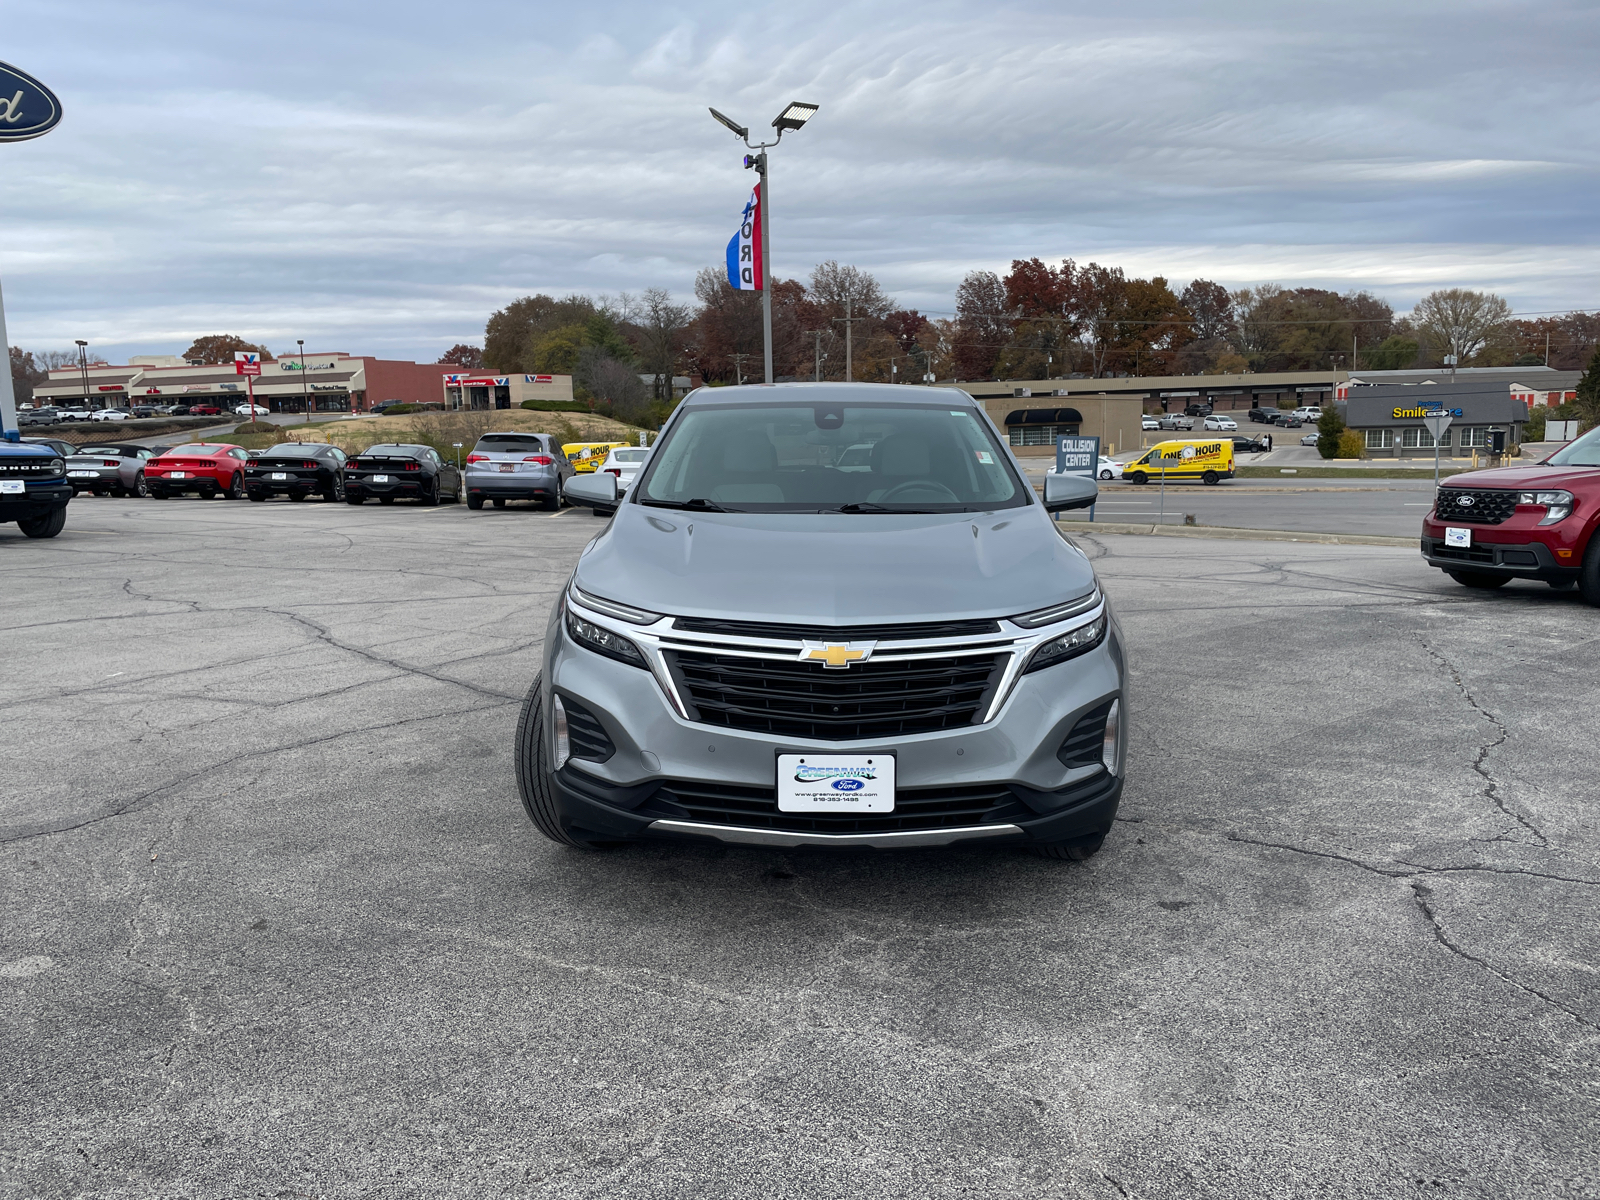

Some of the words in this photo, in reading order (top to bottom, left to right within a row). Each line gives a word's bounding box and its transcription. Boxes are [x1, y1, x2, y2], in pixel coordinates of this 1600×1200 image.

[591, 445, 610, 456] HOUR
[1062, 439, 1095, 452] COLLISION
[1164, 450, 1182, 460] ONE
[1196, 443, 1221, 456] HOUR
[1066, 453, 1090, 467] CENTER
[796, 765, 876, 777] GREENWAY
[838, 780, 858, 790] Ford
